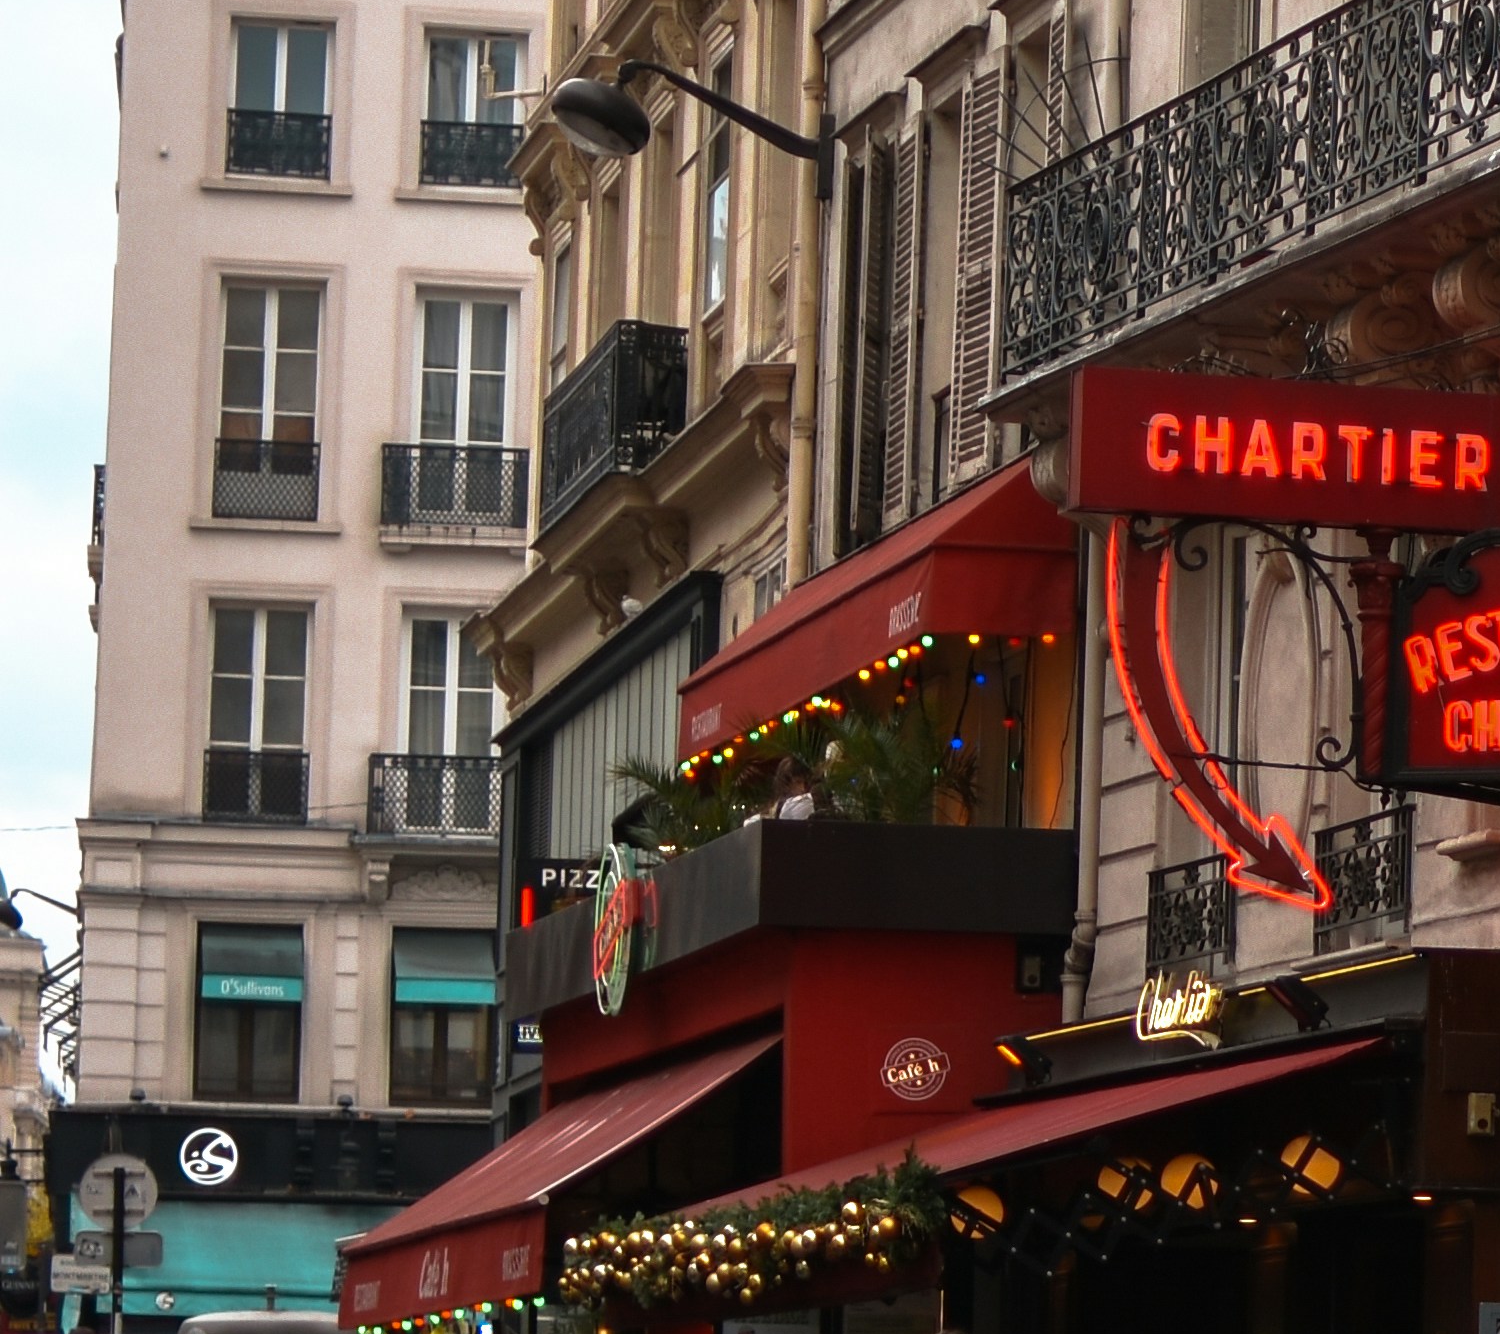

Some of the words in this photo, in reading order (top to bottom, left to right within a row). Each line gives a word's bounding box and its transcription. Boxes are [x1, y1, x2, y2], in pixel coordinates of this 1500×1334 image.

[1145, 411, 1492, 493] CHARTIER
[220, 977, 285, 998] O'Sullivans
[887, 1062, 924, 1083] Café
[927, 1058, 940, 1073] h
